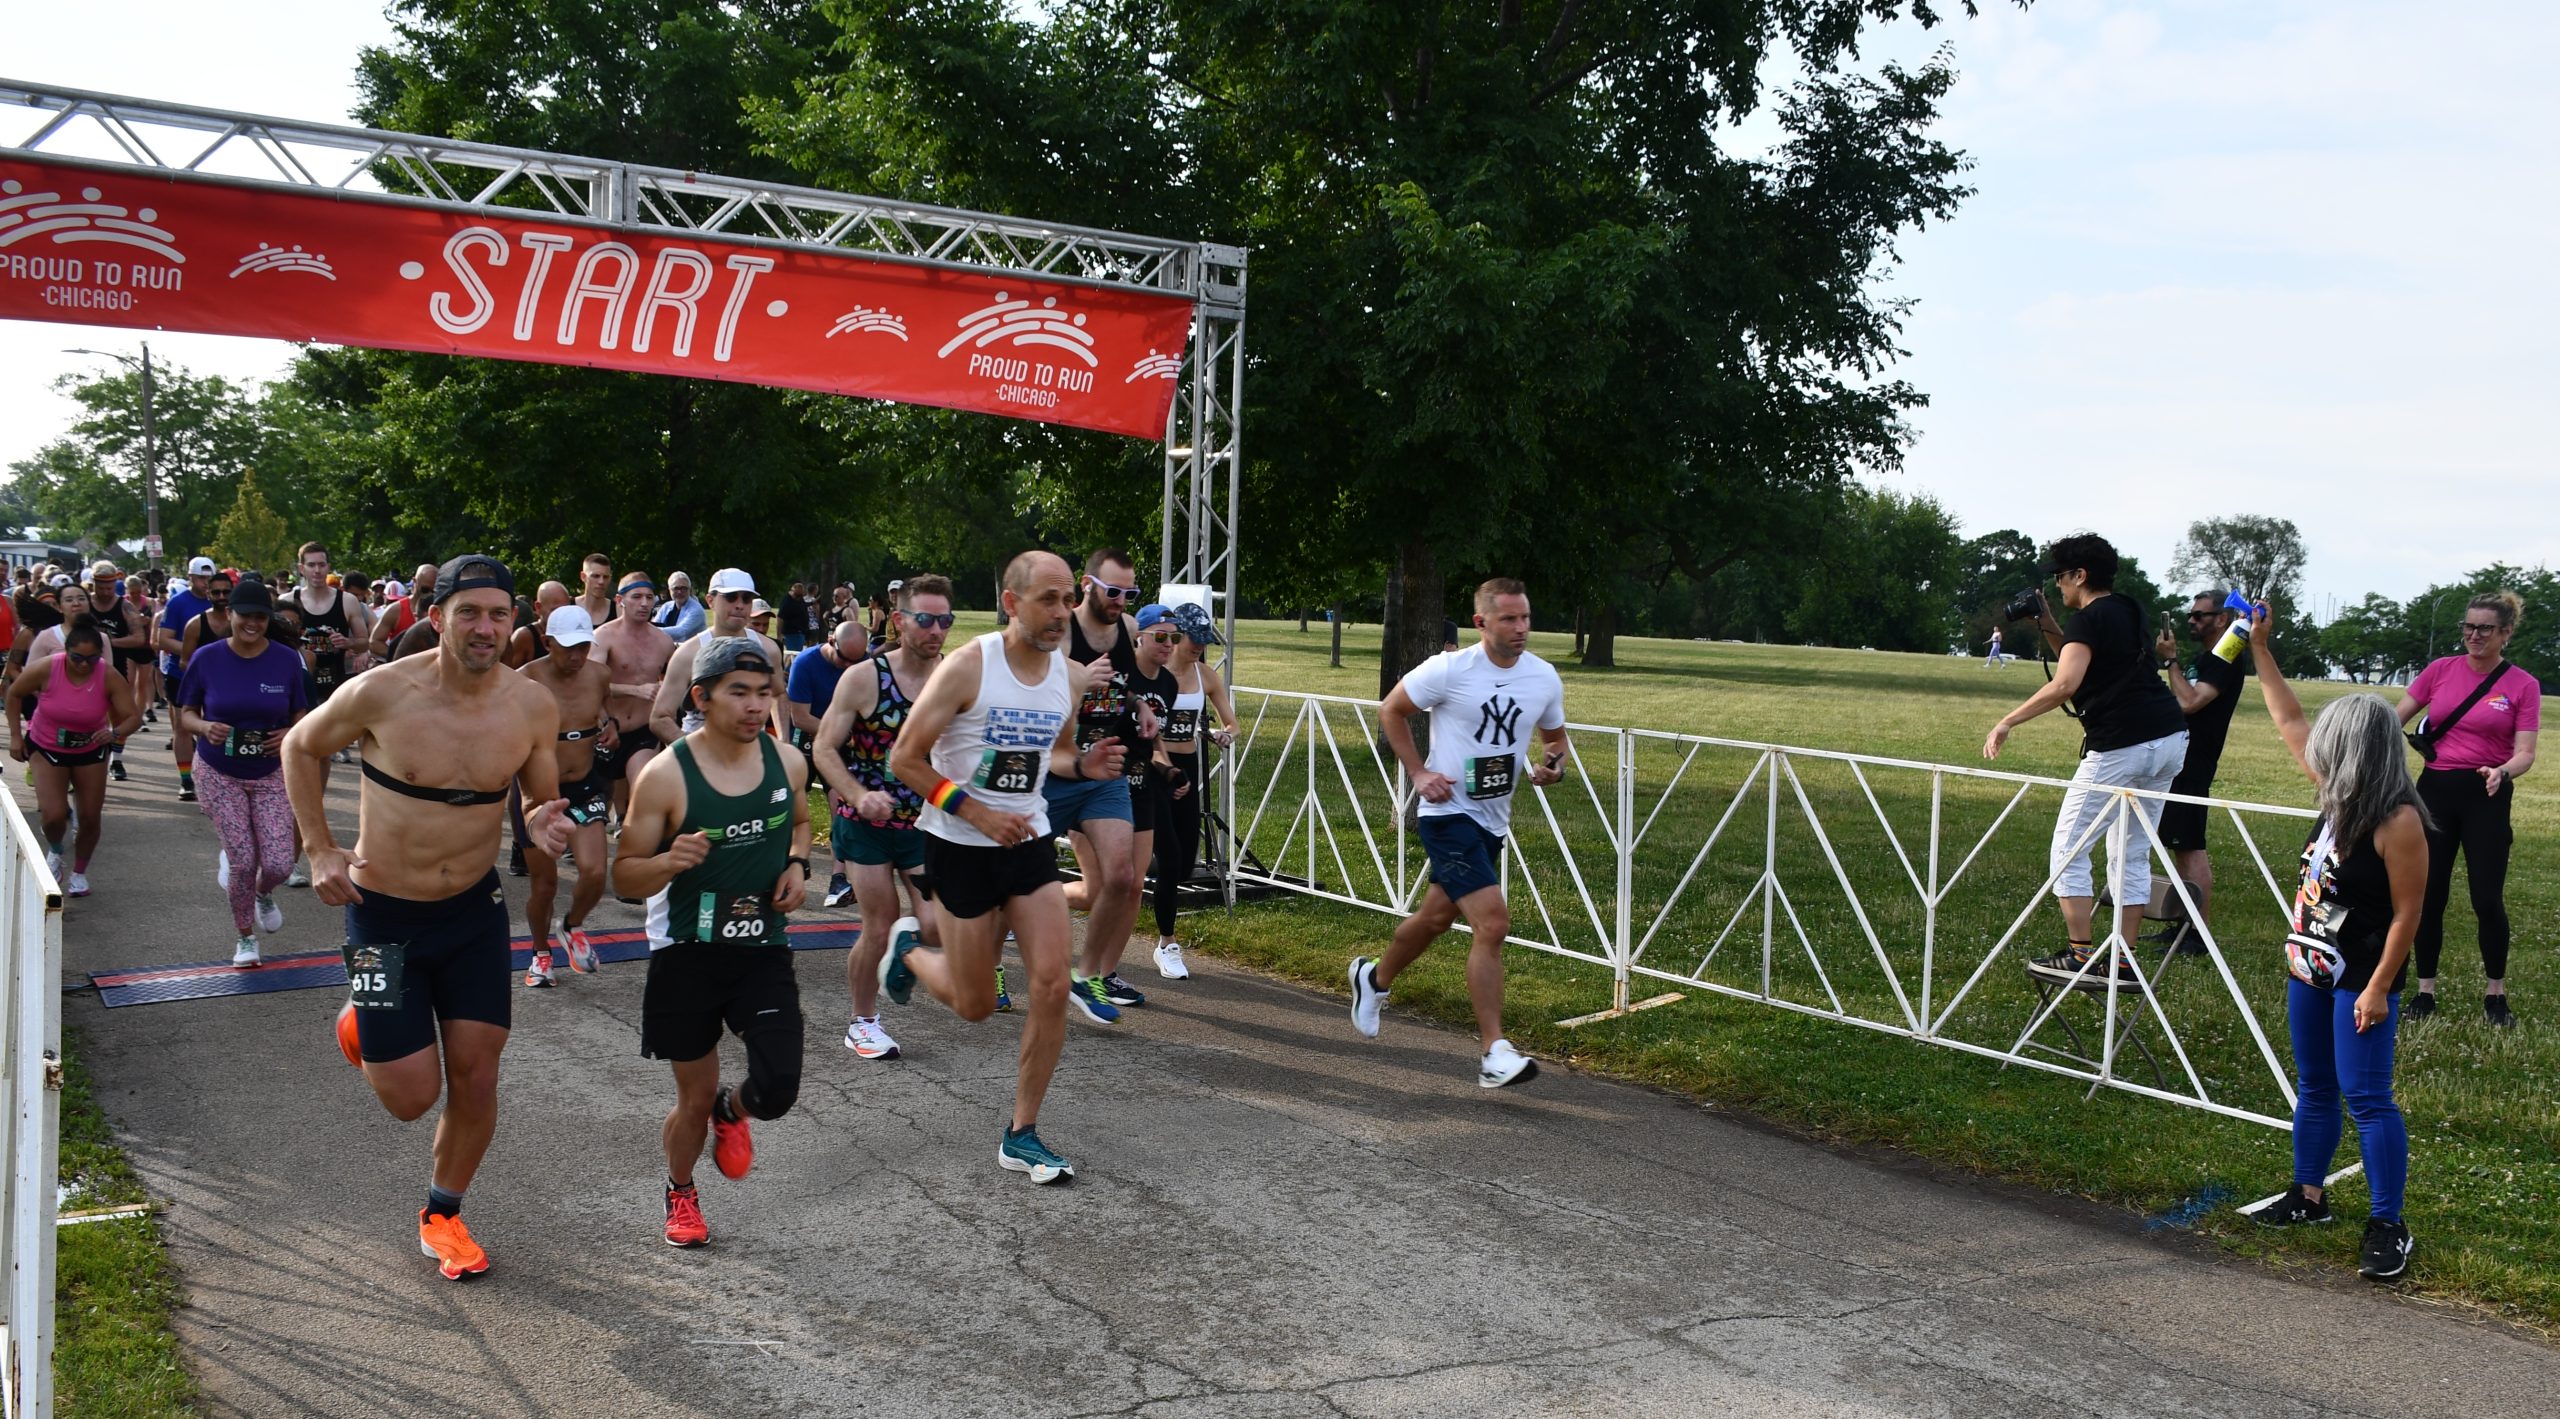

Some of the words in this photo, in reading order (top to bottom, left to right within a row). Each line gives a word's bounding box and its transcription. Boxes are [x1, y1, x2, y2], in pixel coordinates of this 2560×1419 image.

[0, 254, 83, 283] PROUD
[94, 261, 122, 286] TO
[131, 264, 182, 291] RUN
[429, 226, 775, 362] START
[968, 353, 1028, 382] PROUD
[1034, 363, 1054, 386] TO
[1057, 367, 1094, 393] RUN
[1171, 723, 1192, 734] 534
[996, 773, 1029, 788] 612
[1482, 773, 1509, 788] 532
[588, 802, 606, 812] 619
[726, 819, 764, 838] OCR
[699, 909, 714, 929] 5K
[722, 919, 764, 938] 620
[352, 973, 387, 991] 615
